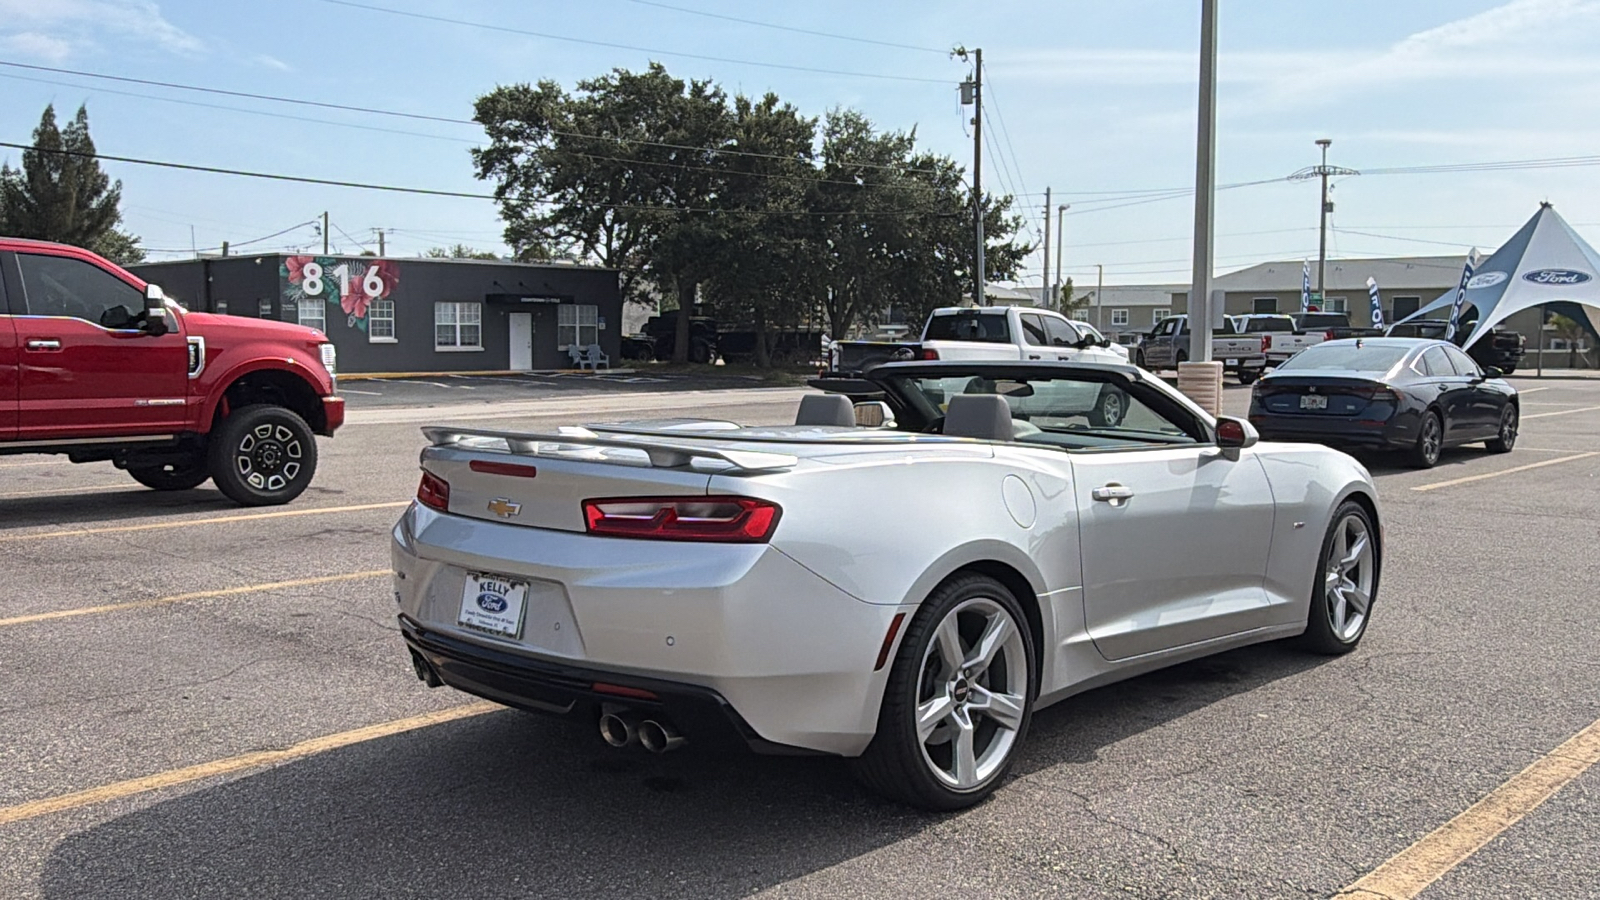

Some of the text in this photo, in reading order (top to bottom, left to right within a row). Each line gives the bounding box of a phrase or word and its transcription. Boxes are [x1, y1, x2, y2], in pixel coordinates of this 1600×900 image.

[302, 262, 384, 297] 816
[1447, 270, 1471, 340] FORD
[479, 581, 510, 597] KELLY
[480, 594, 503, 611] Ford
